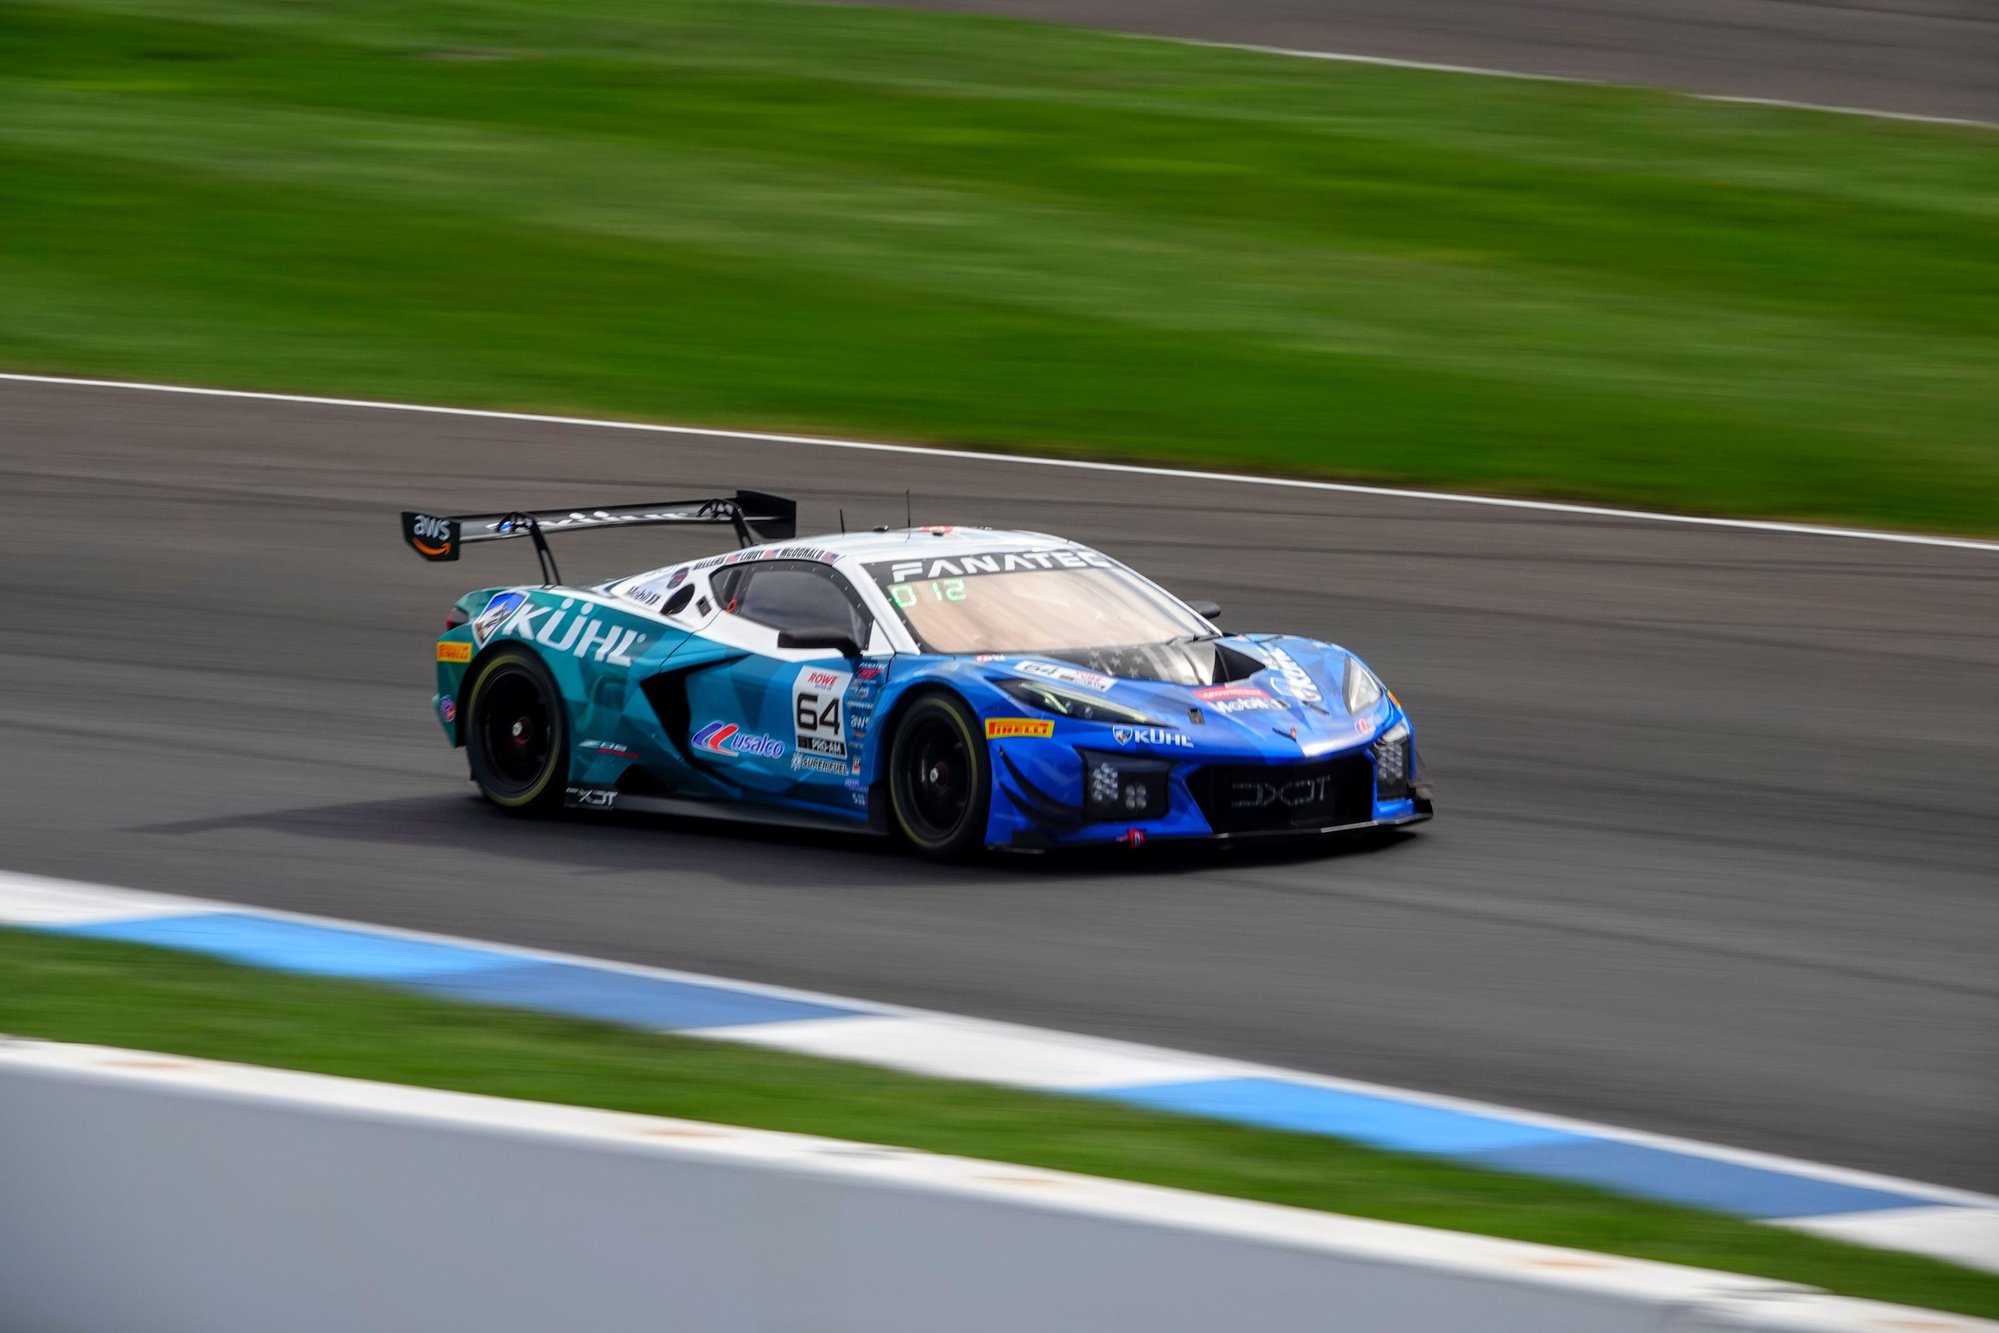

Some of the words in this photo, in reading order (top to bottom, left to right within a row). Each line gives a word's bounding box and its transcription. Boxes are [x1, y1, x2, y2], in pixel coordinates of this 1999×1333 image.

[414, 515, 450, 540] aws
[892, 550, 1112, 583] FANATEC
[808, 672, 838, 687] ROWE
[797, 692, 840, 735] 64
[988, 721, 1049, 735] PIRELLI
